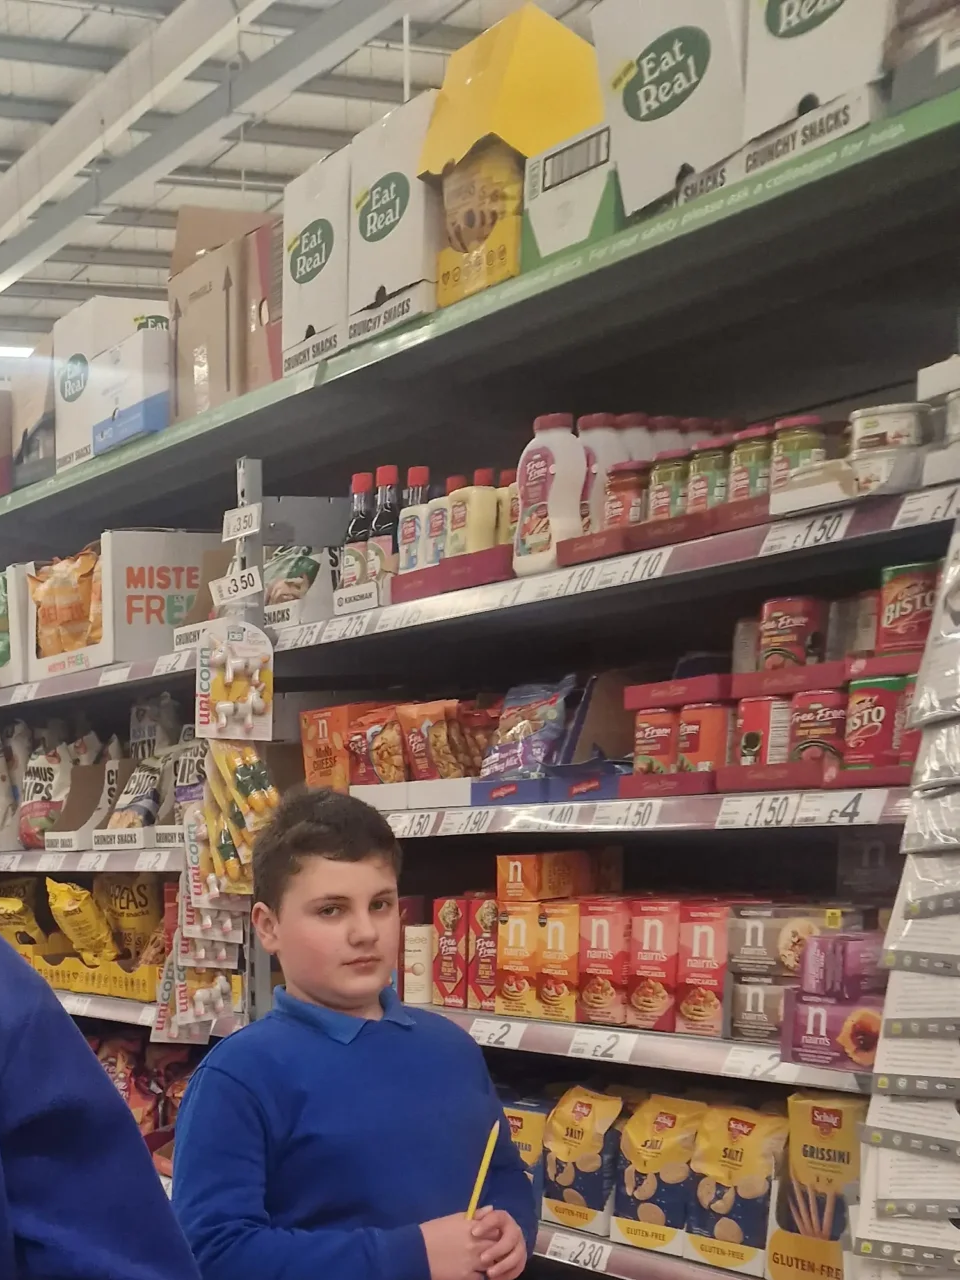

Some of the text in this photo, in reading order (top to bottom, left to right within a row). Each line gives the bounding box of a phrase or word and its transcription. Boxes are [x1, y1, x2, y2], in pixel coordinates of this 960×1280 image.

[640, 38, 685, 84] Eat
[637, 57, 699, 117] Real
[745, 105, 850, 173] CRUNCHY SNACKS
[371, 181, 397, 211] Eat
[683, 168, 726, 202] SNACKS
[366, 200, 400, 237] Real
[300, 227, 323, 254] Eat
[296, 247, 326, 279] Real
[147, 318, 168, 331] Eat
[348, 298, 411, 339] CRUNCHY SNACKS
[284, 334, 337, 372] CRUNCHY SNACKS
[64, 375, 85, 399] Real
[126, 566, 200, 590] MISTE
[264, 608, 290, 625] SNACKS
[882, 596, 936, 629] BISTO
[175, 628, 200, 646] CRUNCHY
[197, 647, 211, 726] unicorn
[846, 705, 886, 735] ISTO
[827, 793, 864, 824] £4
[94, 833, 137, 845] CRUNCHY SNACKS
[509, 860, 522, 882] n
[439, 936, 457, 948] Free
[476, 938, 496, 951] Free
[508, 918, 527, 948] n
[547, 920, 565, 950] n
[591, 918, 609, 949] n
[642, 918, 664, 951] n
[692, 925, 715, 958] n
[745, 919, 765, 947] n
[746, 986, 765, 1013] n
[486, 1022, 512, 1048] £2
[805, 1005, 828, 1037] n
[591, 1033, 621, 1060] £2
[801, 1144, 851, 1166] GRISSINI
[554, 1206, 589, 1221] GLUTEN-FREE
[625, 1225, 666, 1243] GLUTEN-FREE
[700, 1243, 745, 1261] GLUTEN-FREE
[772, 1251, 843, 1280] GLUTEN-FRE
